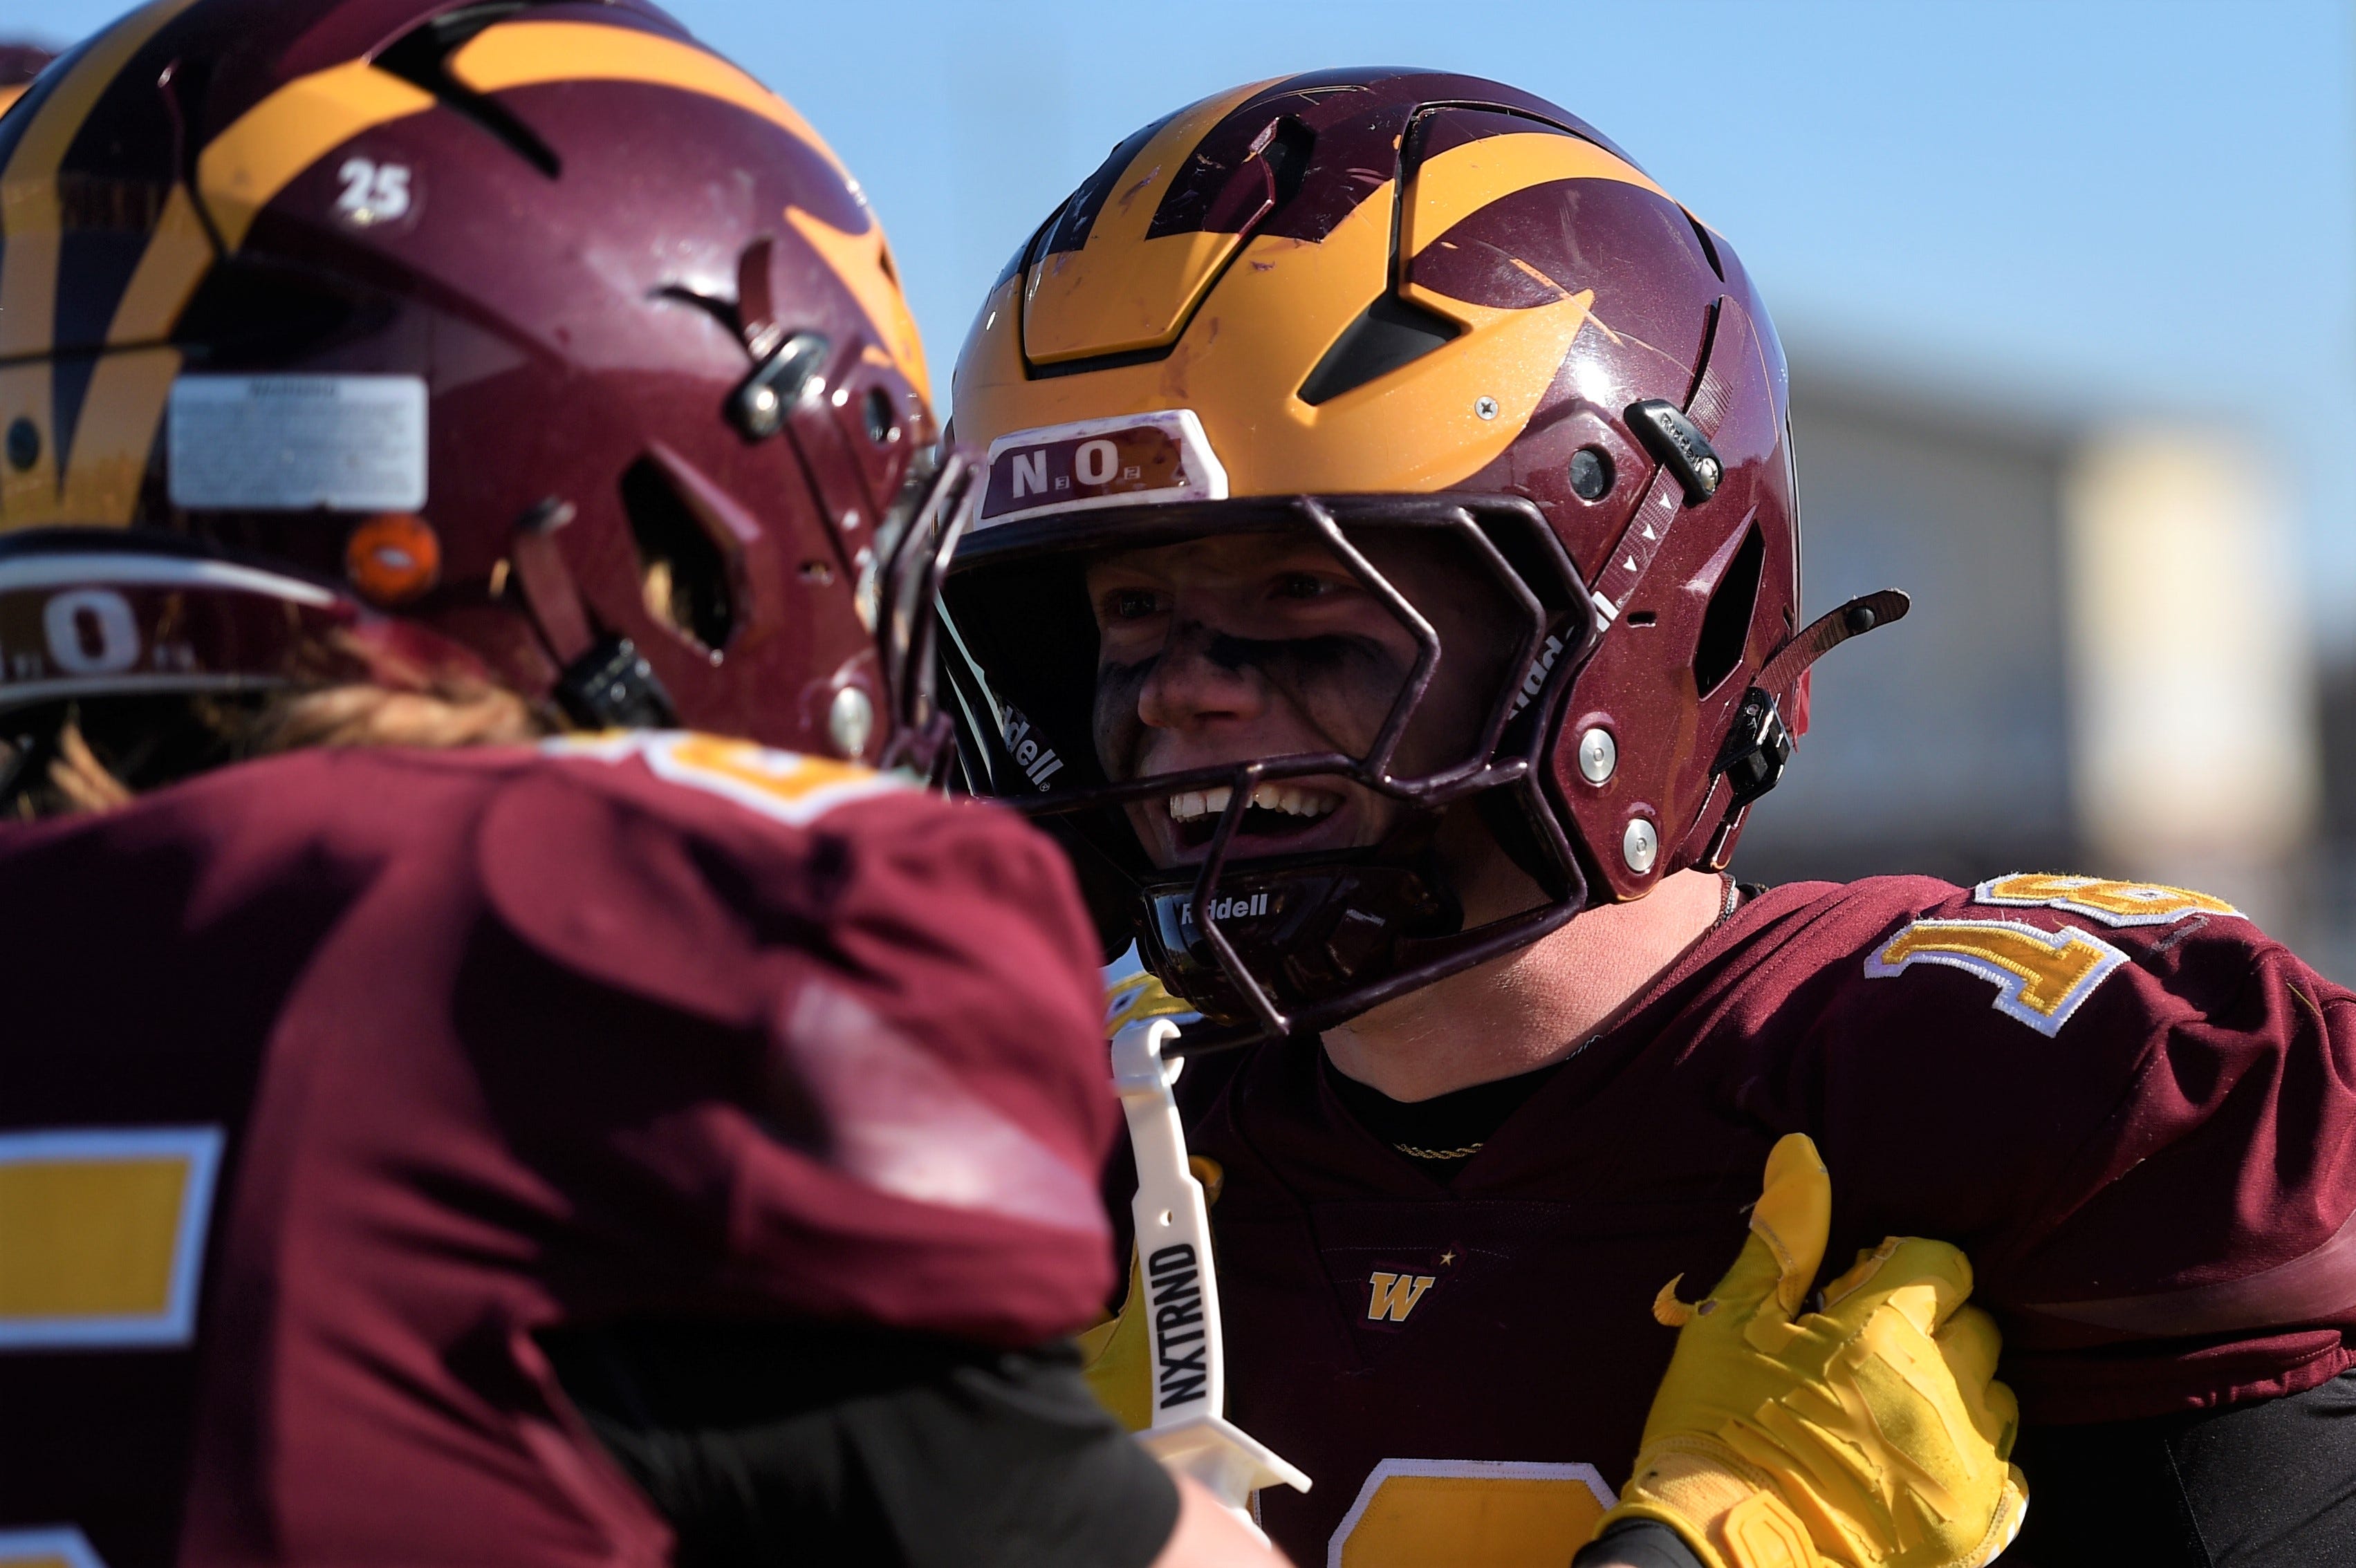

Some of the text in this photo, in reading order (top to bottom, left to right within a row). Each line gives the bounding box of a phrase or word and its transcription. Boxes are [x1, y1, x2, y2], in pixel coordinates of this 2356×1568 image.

[337, 158, 410, 222] 25
[1181, 894, 1268, 925] Rddell
[1367, 1271, 1436, 1321] W
[1149, 1244, 1207, 1410] NXTRND
